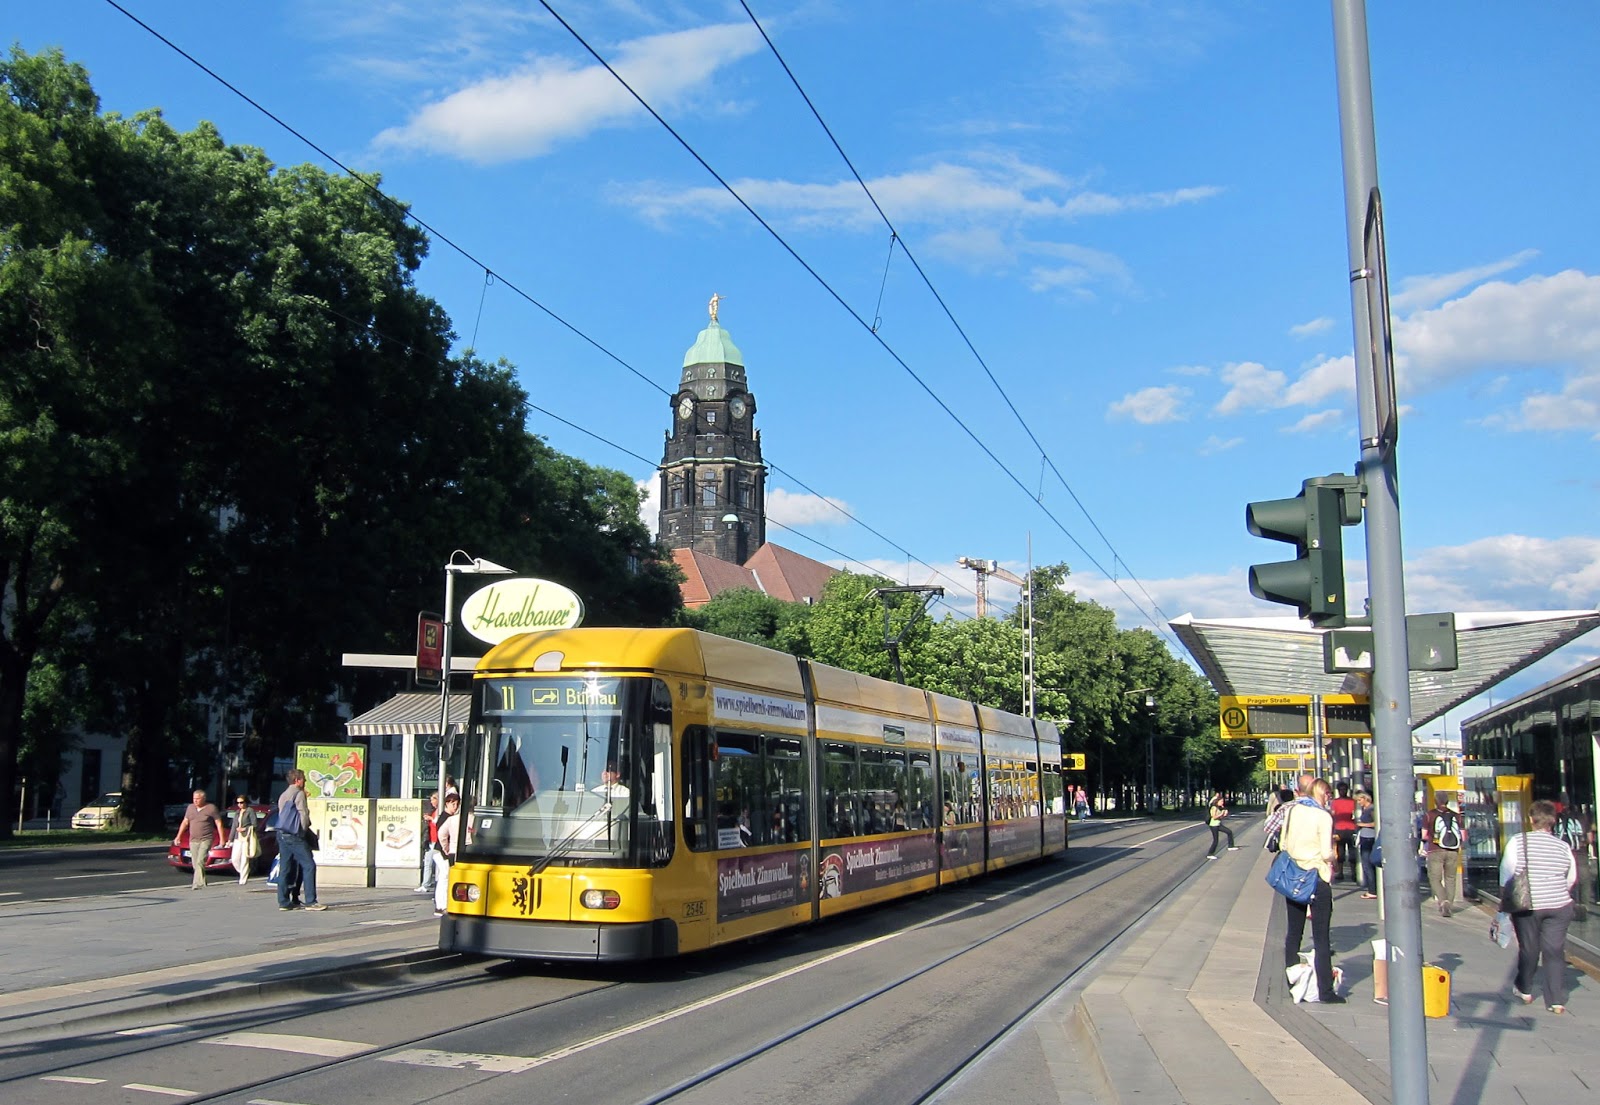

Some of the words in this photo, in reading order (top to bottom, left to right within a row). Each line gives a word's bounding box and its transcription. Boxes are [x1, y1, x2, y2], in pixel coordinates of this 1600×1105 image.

[472, 585, 570, 630] Haselbauer
[501, 686, 514, 710] 11
[846, 847, 875, 875] Spielbank
[719, 867, 756, 897] Spielbank
